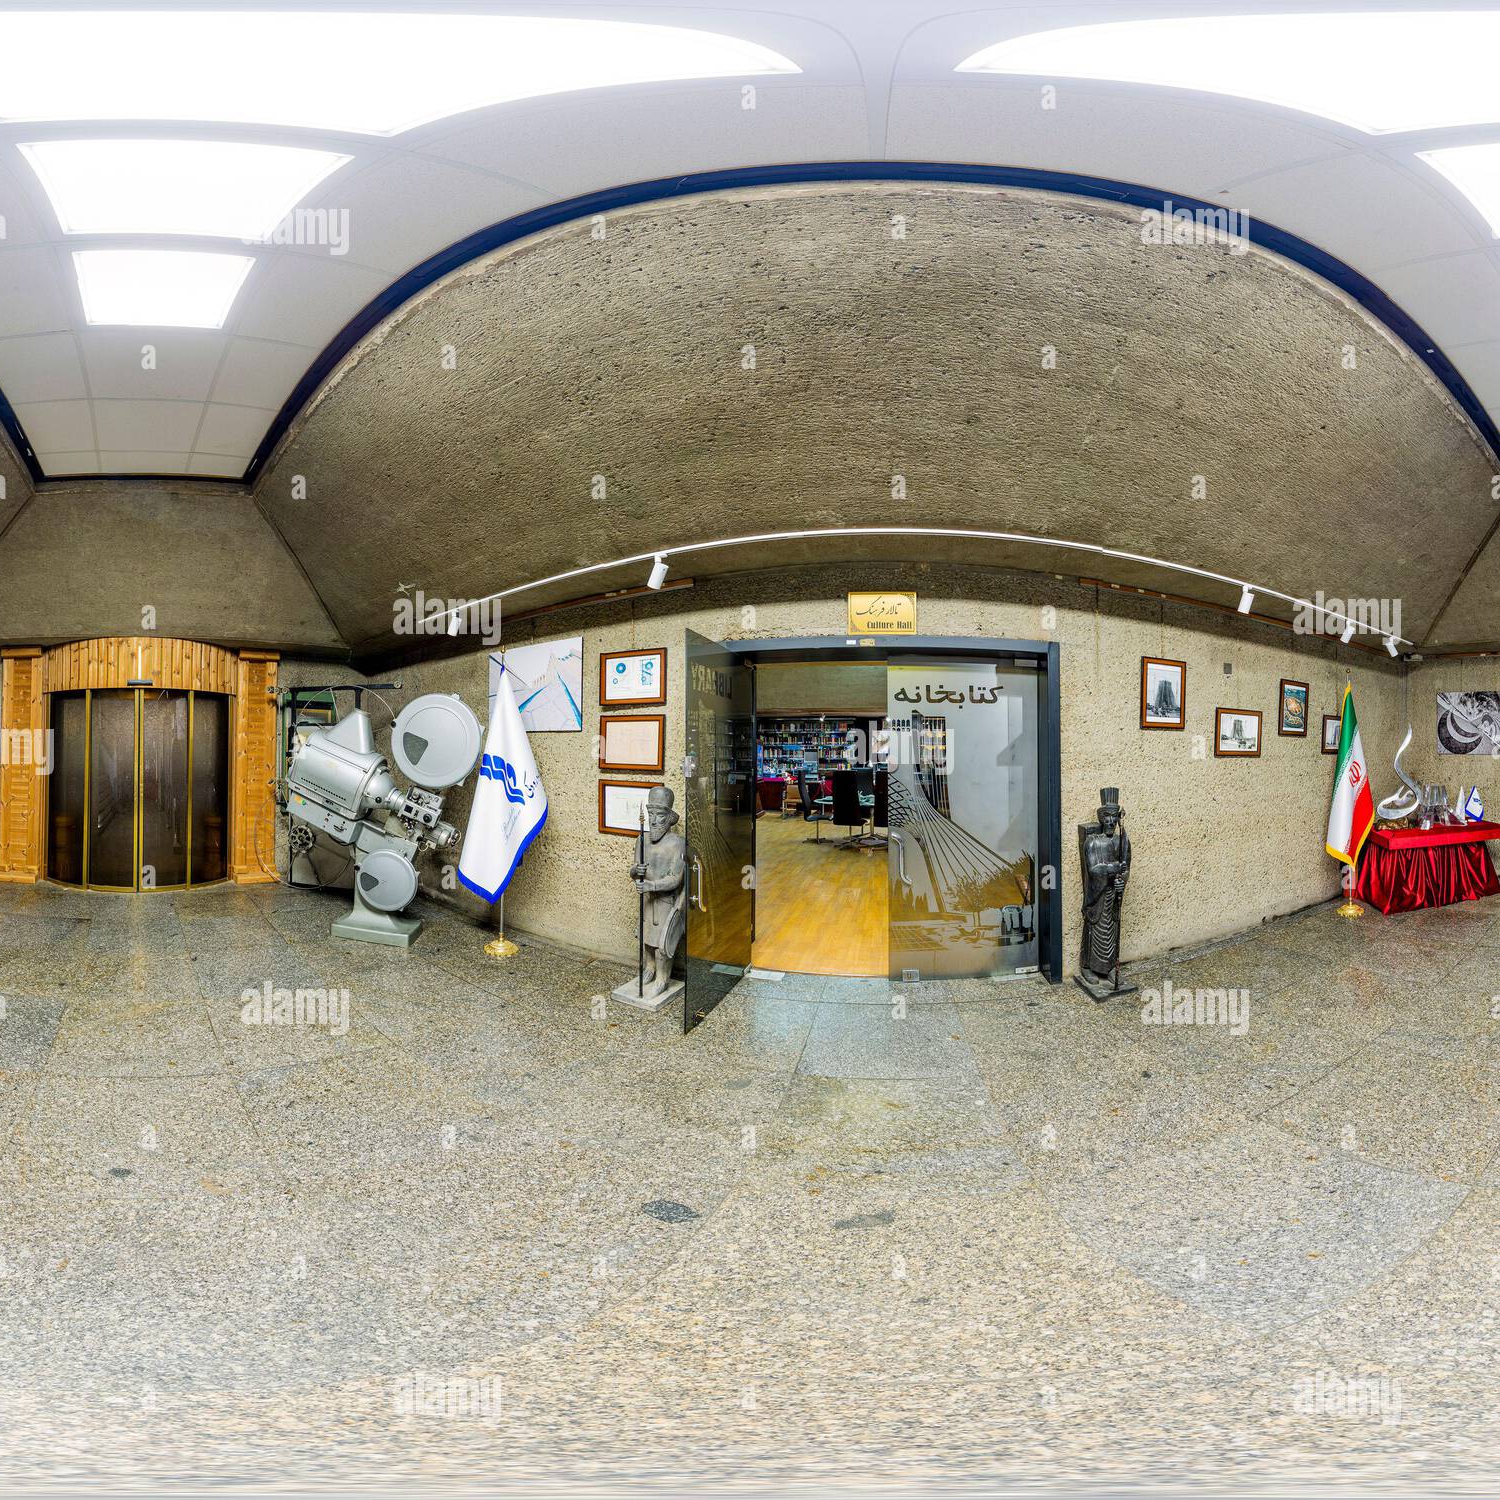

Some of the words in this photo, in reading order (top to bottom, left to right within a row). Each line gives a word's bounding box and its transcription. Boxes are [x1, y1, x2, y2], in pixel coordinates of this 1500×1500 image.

[866, 620, 894, 630] Culture
[896, 620, 912, 630] Hall
[893, 684, 1005, 710] کتابخانه
